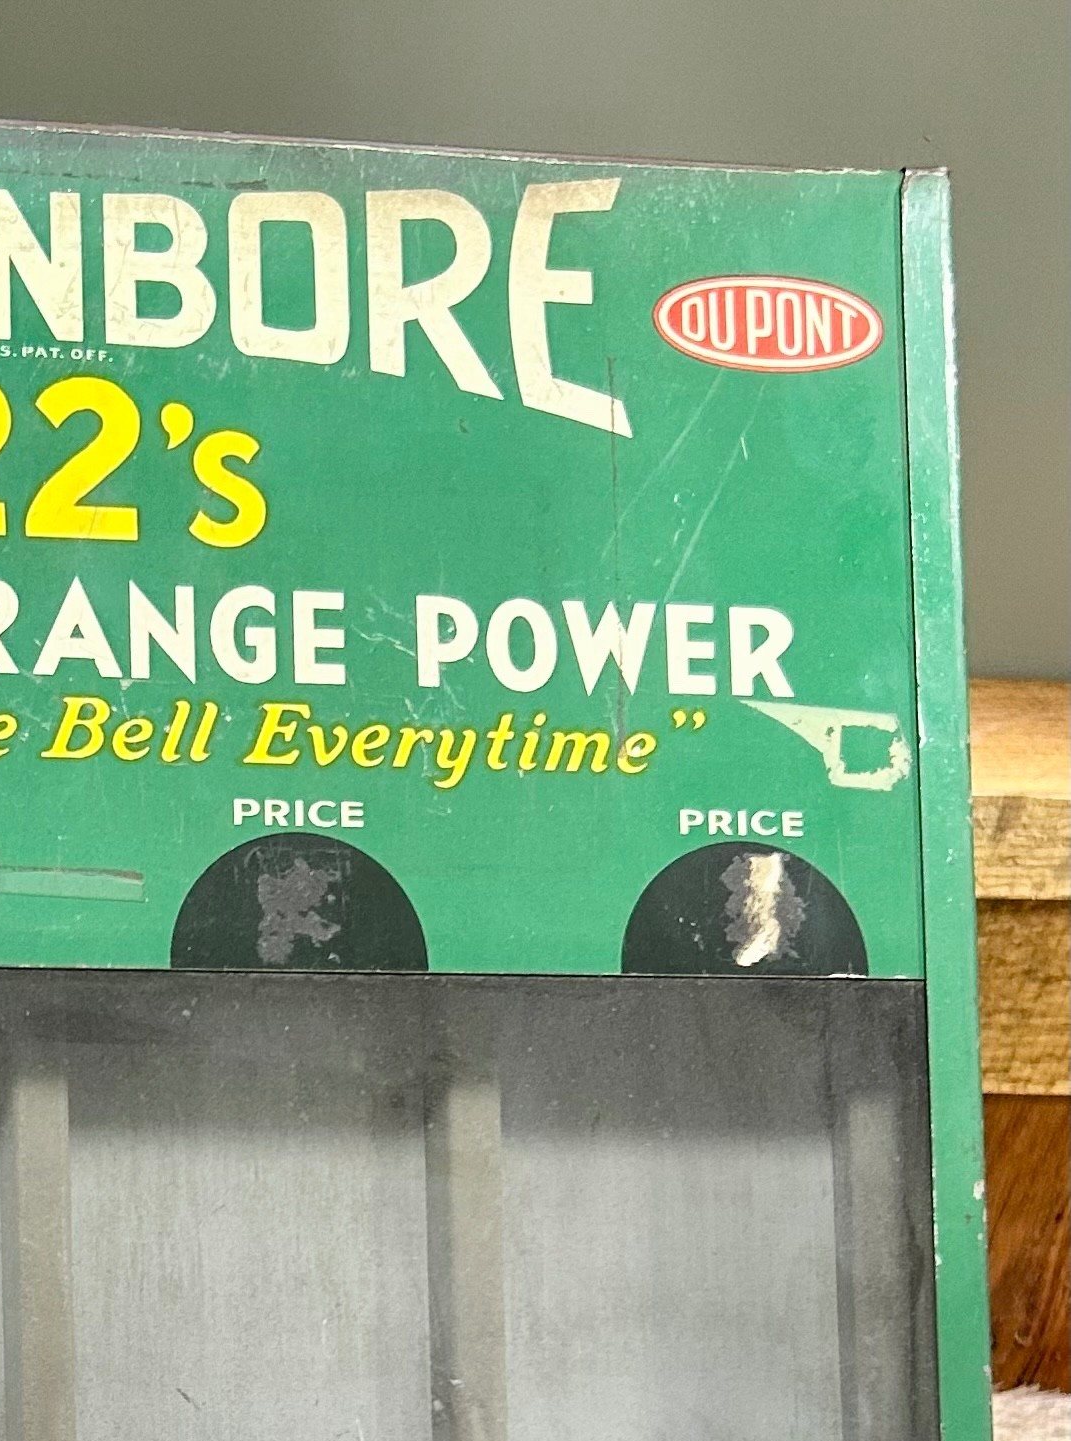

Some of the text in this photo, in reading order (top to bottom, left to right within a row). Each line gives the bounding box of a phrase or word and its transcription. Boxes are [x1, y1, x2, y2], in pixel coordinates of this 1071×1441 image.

[21, 346, 64, 359] PAT.
[70, 348, 114, 363] OFF.
[416, 594, 795, 698] POWER
[41, 696, 219, 763] Bell
[232, 798, 365, 828] PRICE
[678, 809, 805, 838] PRICE
